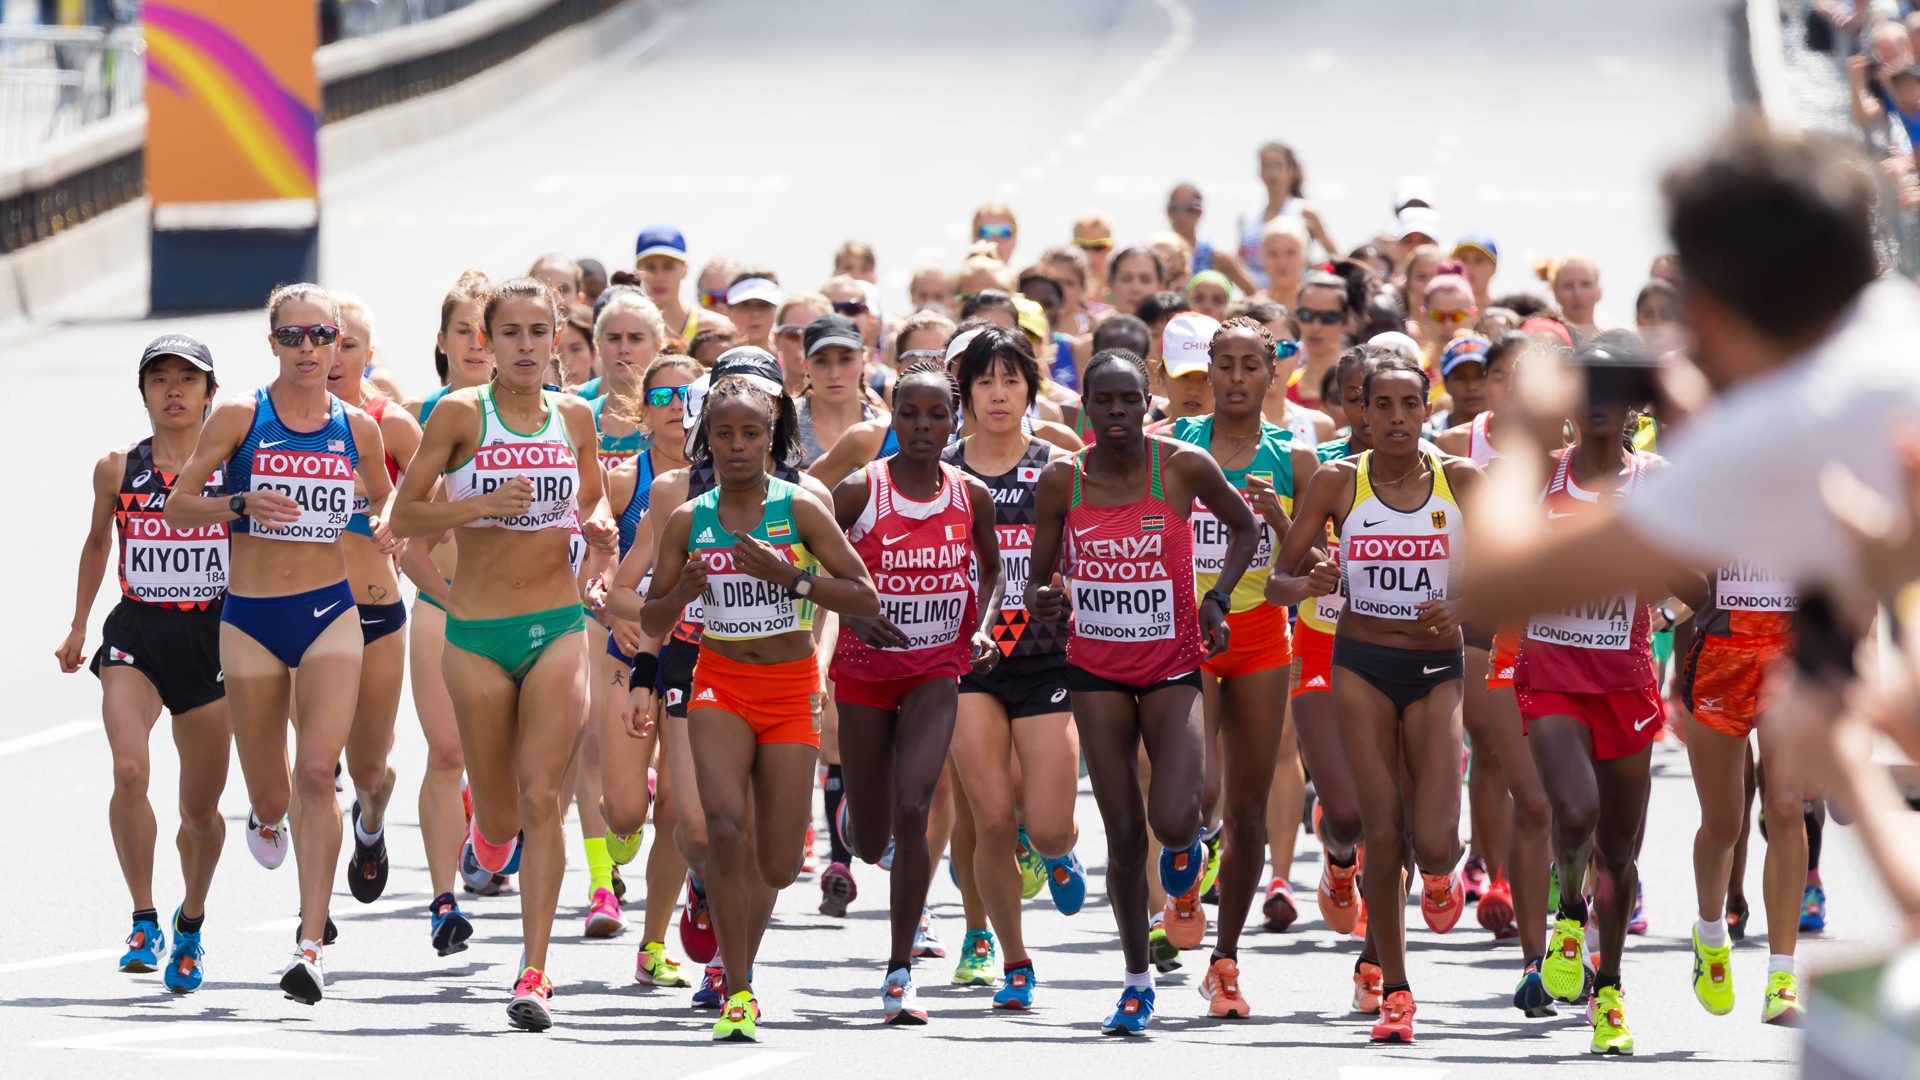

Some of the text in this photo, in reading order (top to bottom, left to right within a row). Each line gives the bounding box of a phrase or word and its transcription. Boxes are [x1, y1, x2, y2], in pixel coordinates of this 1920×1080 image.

[154, 339, 191, 350] JAPAN
[1182, 341, 1210, 351] CHIN
[725, 357, 763, 369] JAPAN
[256, 453, 350, 477] TOYOTA
[477, 446, 572, 468] TOYOTA
[256, 482, 346, 513] AGG
[482, 475, 573, 503] RIRO
[552, 500, 571, 511] 225
[328, 513, 348, 524] 254
[1079, 534, 1162, 559] KENYA
[1352, 539, 1446, 558] TOYOTA
[131, 546, 223, 573] KIYOTA
[881, 542, 967, 571] BAHRAIN
[206, 571, 226, 583] 184
[1077, 560, 1168, 580] TOYOTA
[1363, 566, 1432, 592] TOLA
[875, 571, 966, 592] TOYOTA
[701, 580, 793, 608] M. DIBABA
[1077, 588, 1167, 614] KIPROP
[1425, 588, 1444, 601] 164
[1720, 595, 1782, 608] LONDON
[774, 602, 793, 615] 151
[880, 597, 962, 625] HELIMO
[1355, 598, 1411, 616] LONDON
[708, 615, 795, 634] LONDON 2017
[943, 618, 960, 630] 113
[1150, 612, 1171, 623] 193
[1609, 620, 1629, 632] 115
[930, 630, 958, 645] 2017
[1079, 623, 1171, 638] LONDON 2017
[1532, 624, 1628, 646] LONDON 2017
